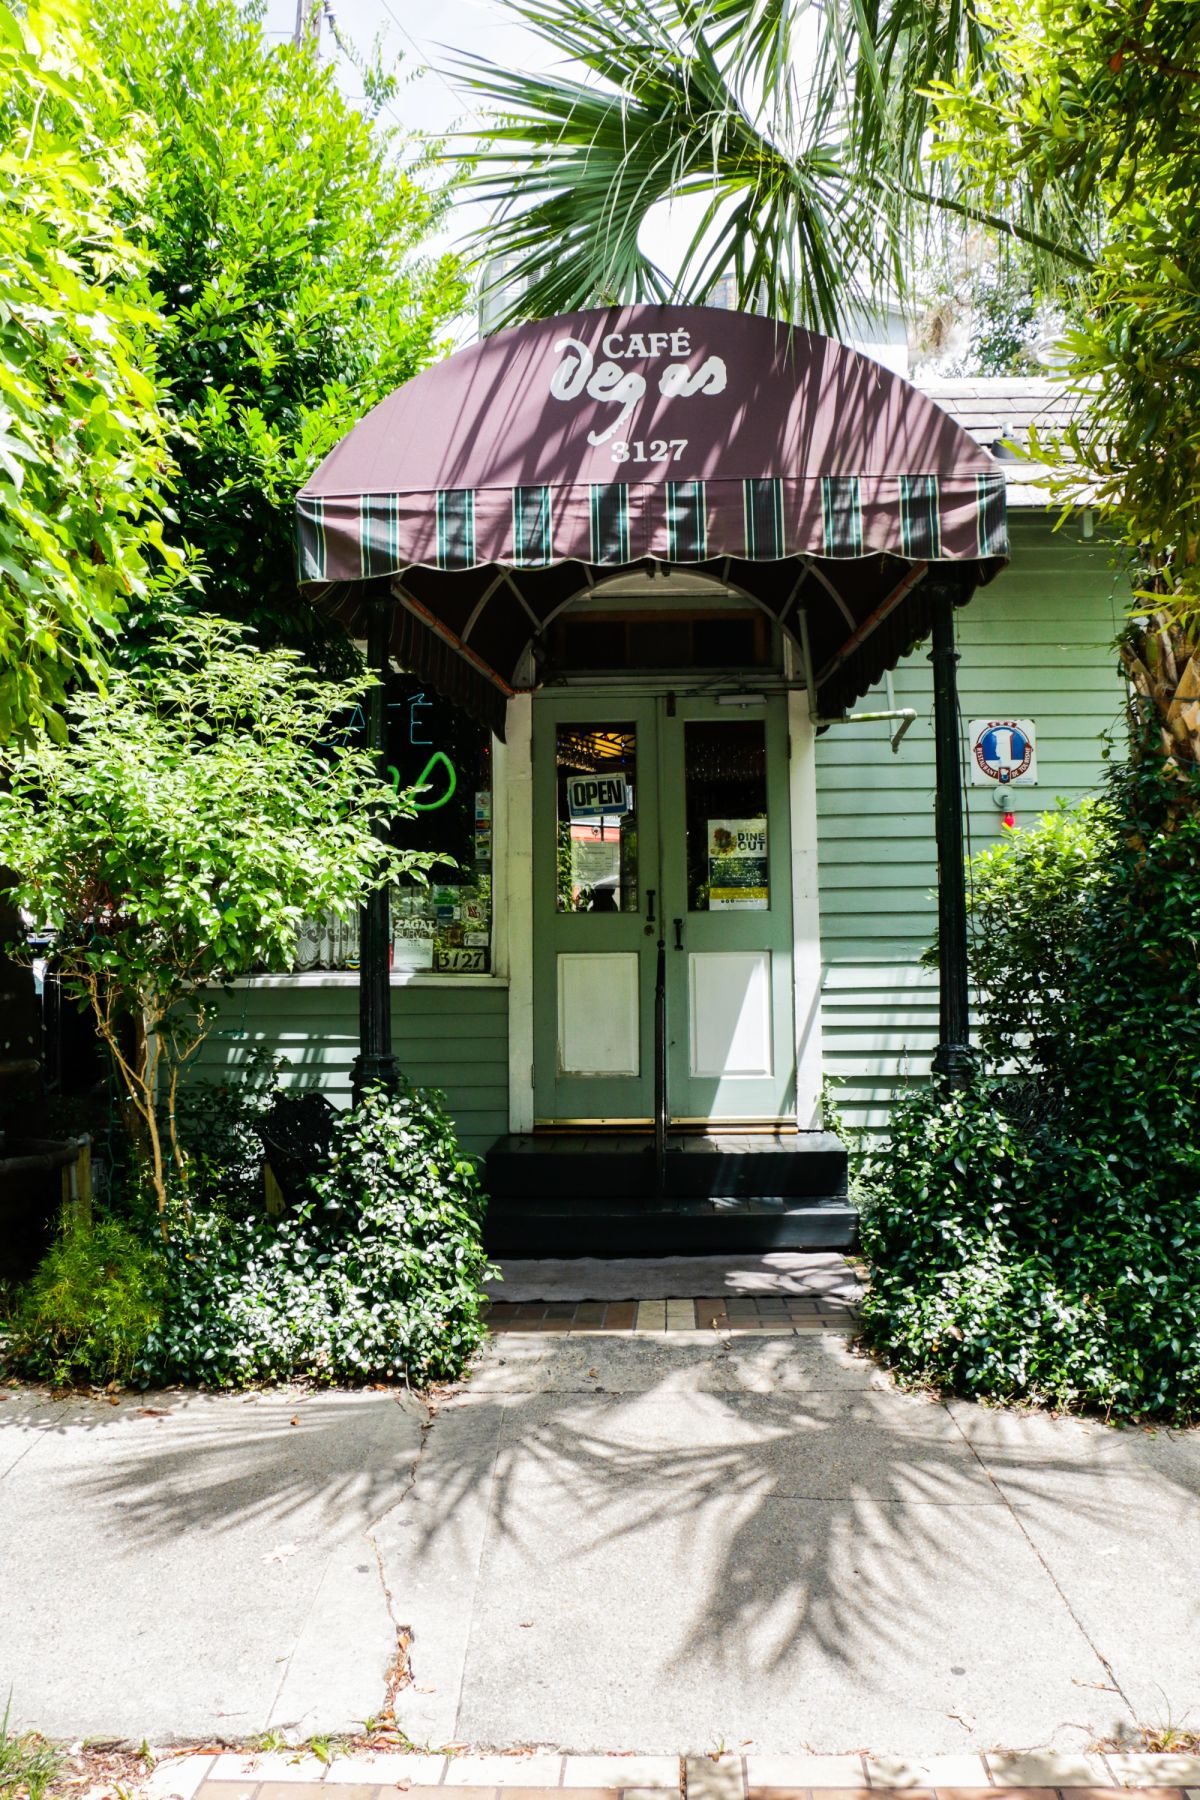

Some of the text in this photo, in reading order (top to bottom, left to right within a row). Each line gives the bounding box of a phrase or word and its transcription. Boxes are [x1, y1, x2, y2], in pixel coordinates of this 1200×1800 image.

[602, 327, 692, 359] CAFÉ
[550, 337, 728, 446] Degas
[610, 439, 689, 463] 3127
[573, 780, 623, 807] OPEN
[737, 832, 767, 841] DINE
[737, 841, 767, 851] OUT
